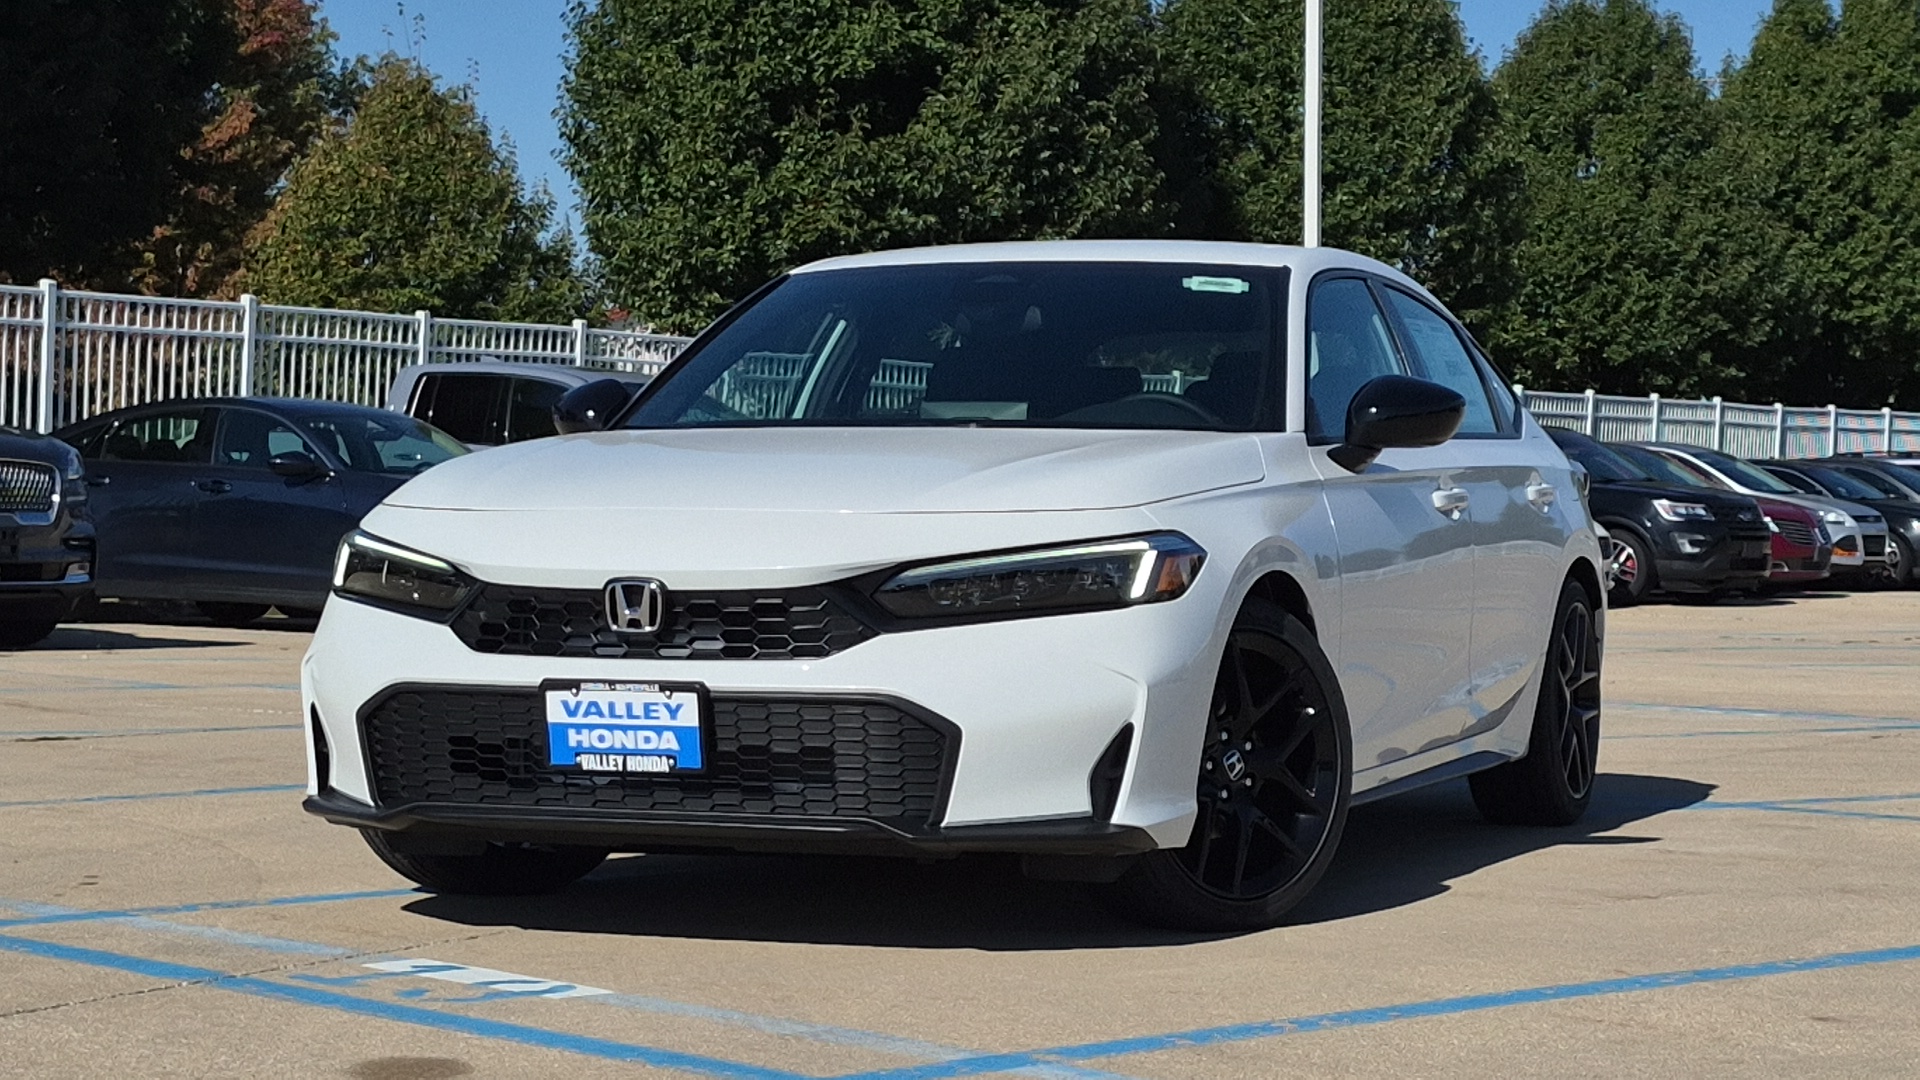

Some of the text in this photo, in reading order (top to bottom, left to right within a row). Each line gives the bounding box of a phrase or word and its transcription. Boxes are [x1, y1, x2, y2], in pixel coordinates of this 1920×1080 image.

[560, 699, 684, 721] VALLEY
[567, 728, 681, 751] HONDA
[580, 753, 670, 773] VALLEY HONDA
